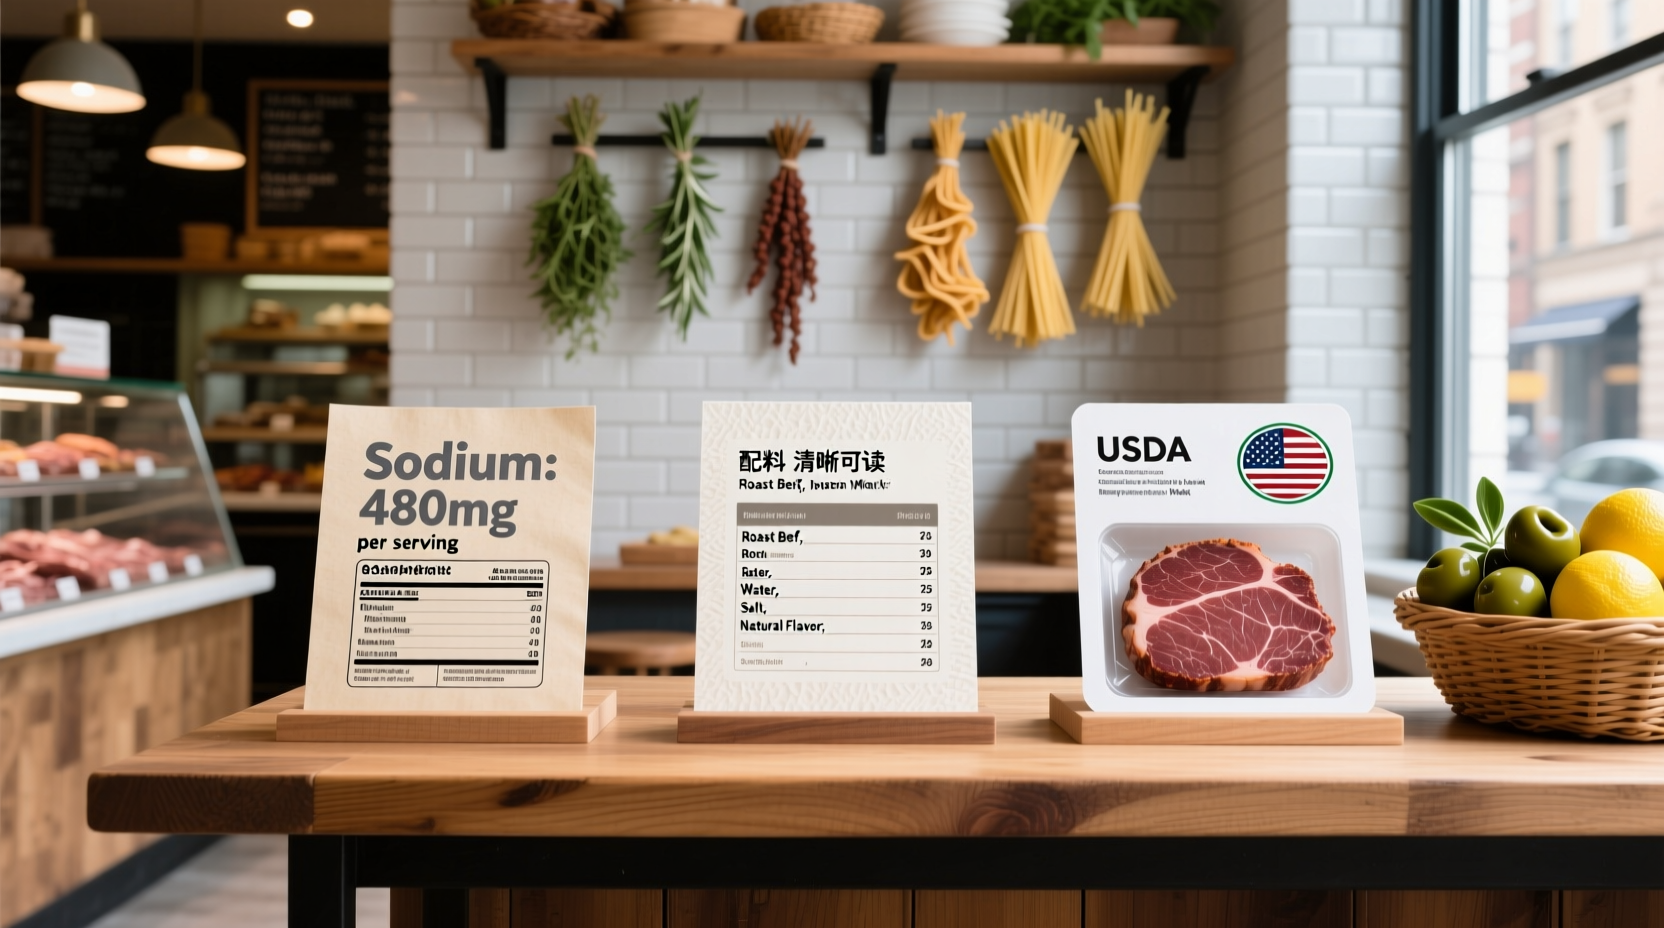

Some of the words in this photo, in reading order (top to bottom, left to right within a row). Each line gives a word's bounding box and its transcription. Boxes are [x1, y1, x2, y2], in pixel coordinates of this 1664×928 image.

[1096, 436, 1192, 462] USDA
[363, 440, 558, 482] Sodium:
[738, 449, 786, 473] 配料
[793, 449, 886, 473] 清晰可读
[738, 478, 774, 490] Roast
[358, 488, 518, 538] 480mg
[357, 536, 388, 554] per
[392, 534, 459, 554] serving
[741, 531, 775, 543] Roast
[741, 584, 779, 598] Water,
[920, 585, 932, 594] 25
[740, 602, 767, 614] Salt,
[740, 620, 783, 631] Natural
[786, 619, 825, 634] Flavor,
